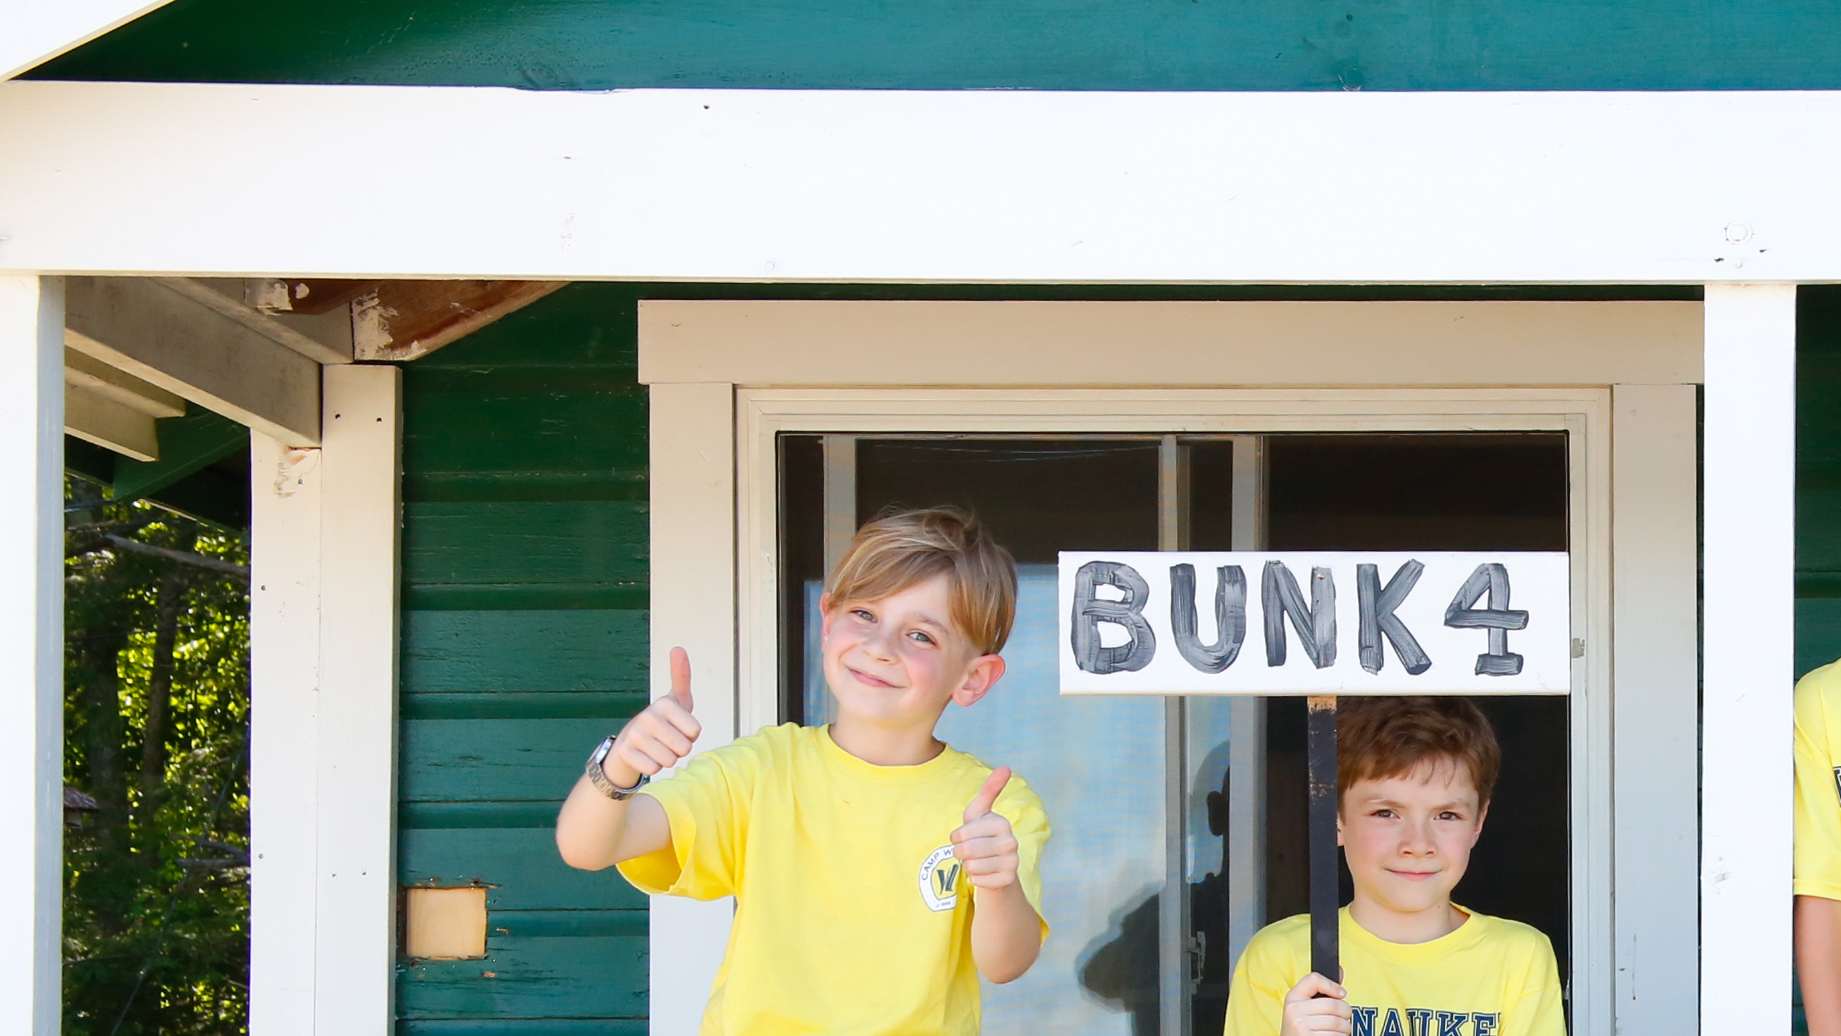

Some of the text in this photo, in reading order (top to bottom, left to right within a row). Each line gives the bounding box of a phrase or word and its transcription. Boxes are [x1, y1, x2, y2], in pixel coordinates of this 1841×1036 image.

[1071, 559, 1529, 676] BUNK 4
[921, 852, 940, 880] CAMP
